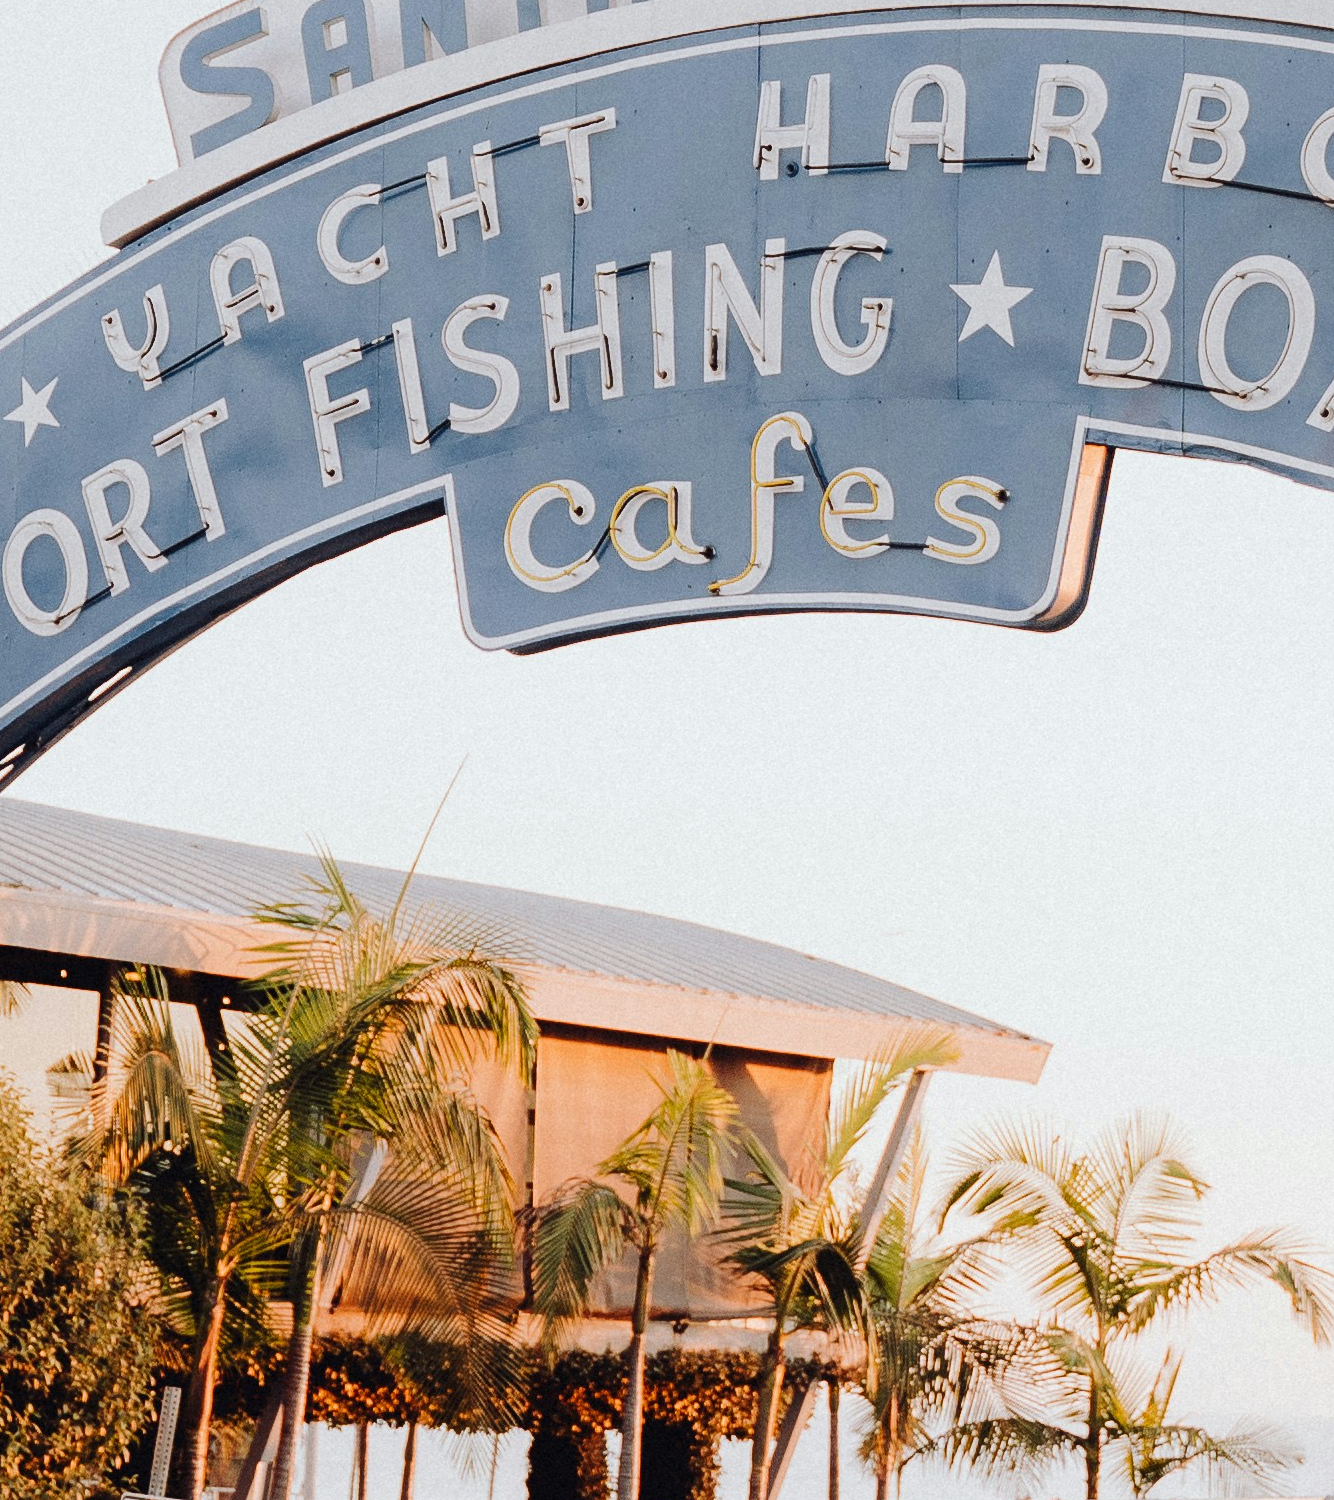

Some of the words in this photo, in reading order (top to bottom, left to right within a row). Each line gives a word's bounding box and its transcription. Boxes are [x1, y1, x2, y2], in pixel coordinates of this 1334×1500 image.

[102, 107, 616, 391] YACHT
[302, 229, 893, 488] FISHING
[503, 410, 1010, 596] cafes
